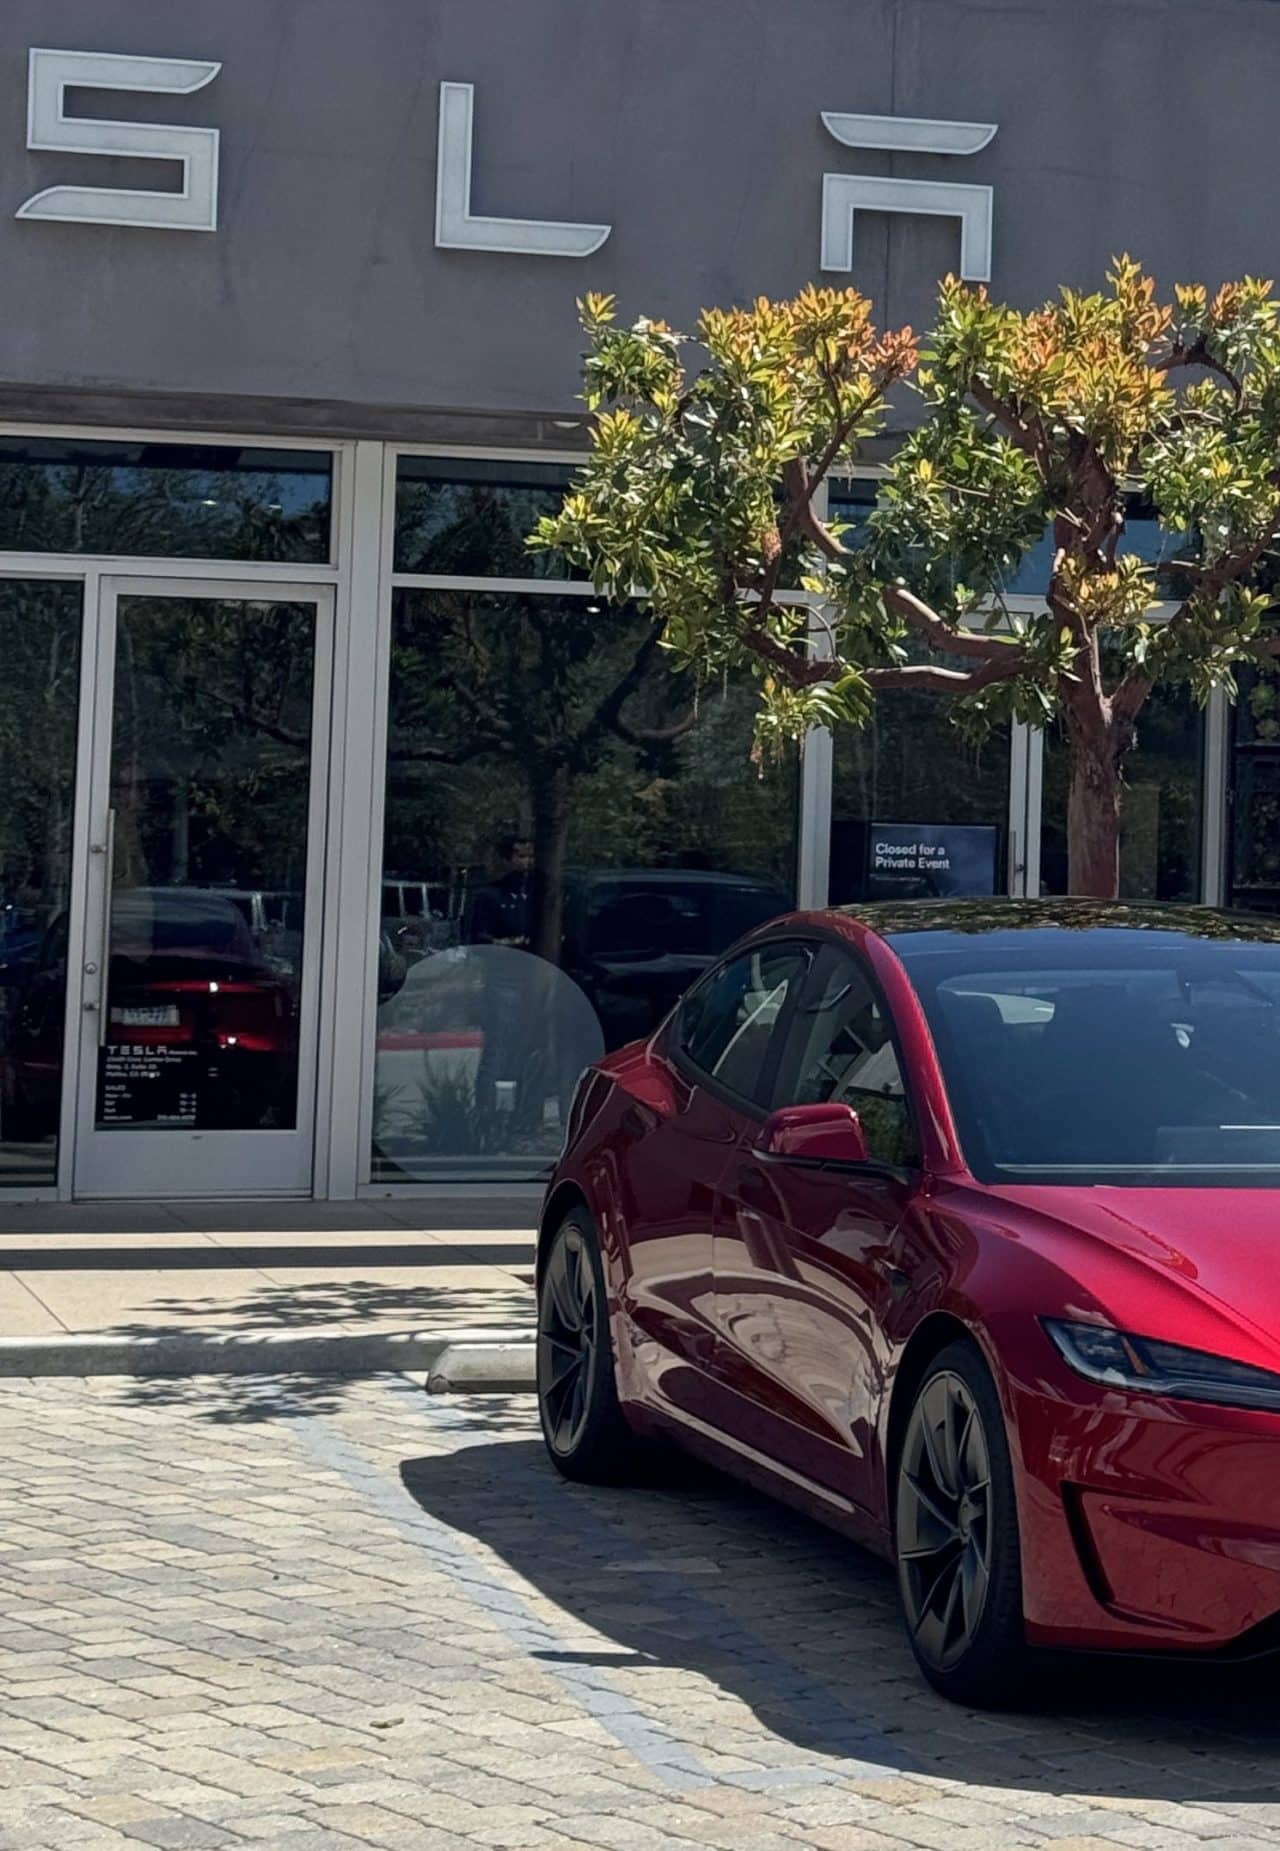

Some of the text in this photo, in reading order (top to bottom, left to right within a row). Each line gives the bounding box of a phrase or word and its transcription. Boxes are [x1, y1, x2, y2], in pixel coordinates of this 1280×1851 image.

[875, 843, 945, 856] Closed for a
[875, 856, 950, 870] Private Event
[106, 1045, 168, 1056] TESLA
